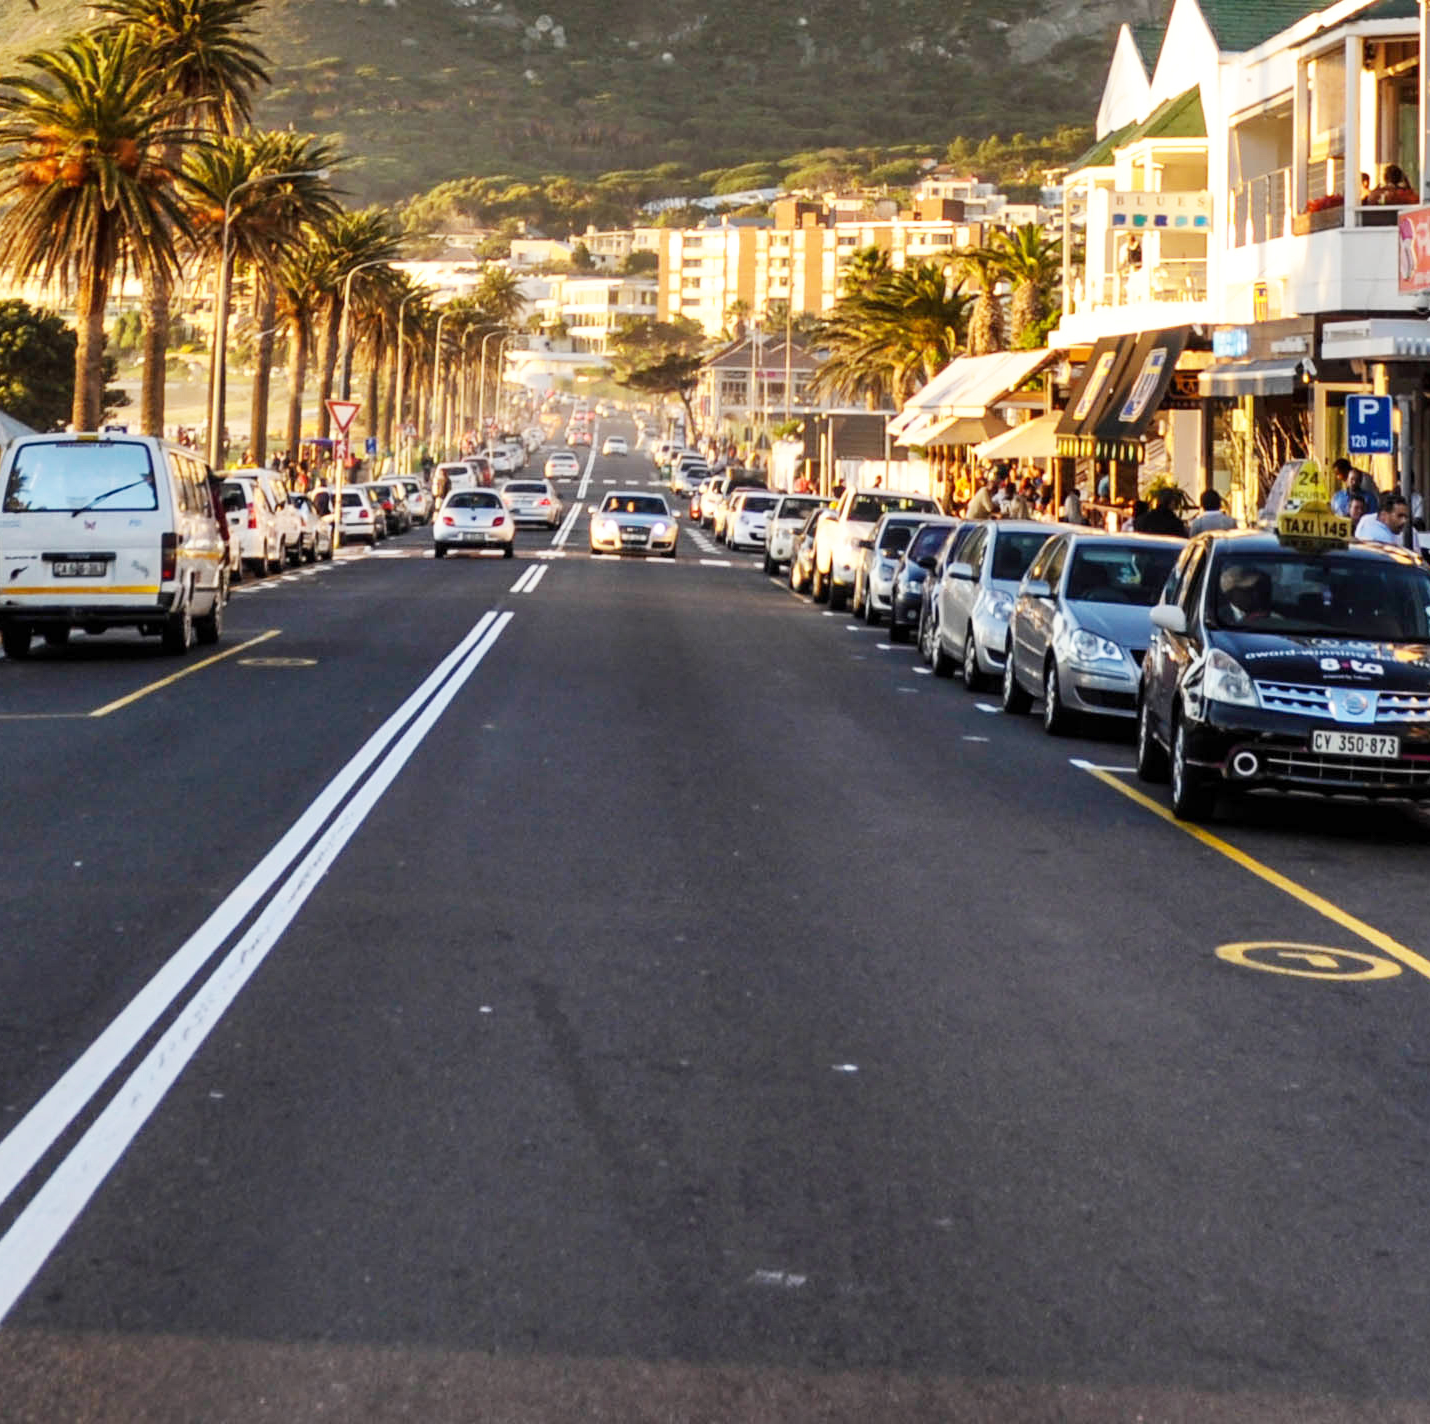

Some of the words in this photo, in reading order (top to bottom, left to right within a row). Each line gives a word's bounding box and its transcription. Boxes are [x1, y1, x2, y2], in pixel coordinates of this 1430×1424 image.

[1115, 195, 1206, 208] BLUES
[1358, 399, 1380, 424] P
[1351, 435, 1368, 448] 120
[1298, 471, 1320, 486] 24
[1284, 517, 1315, 534] TAXI
[1323, 520, 1348, 538] 145
[1314, 735, 1331, 751] CY
[1338, 736, 1397, 755] 350-873
